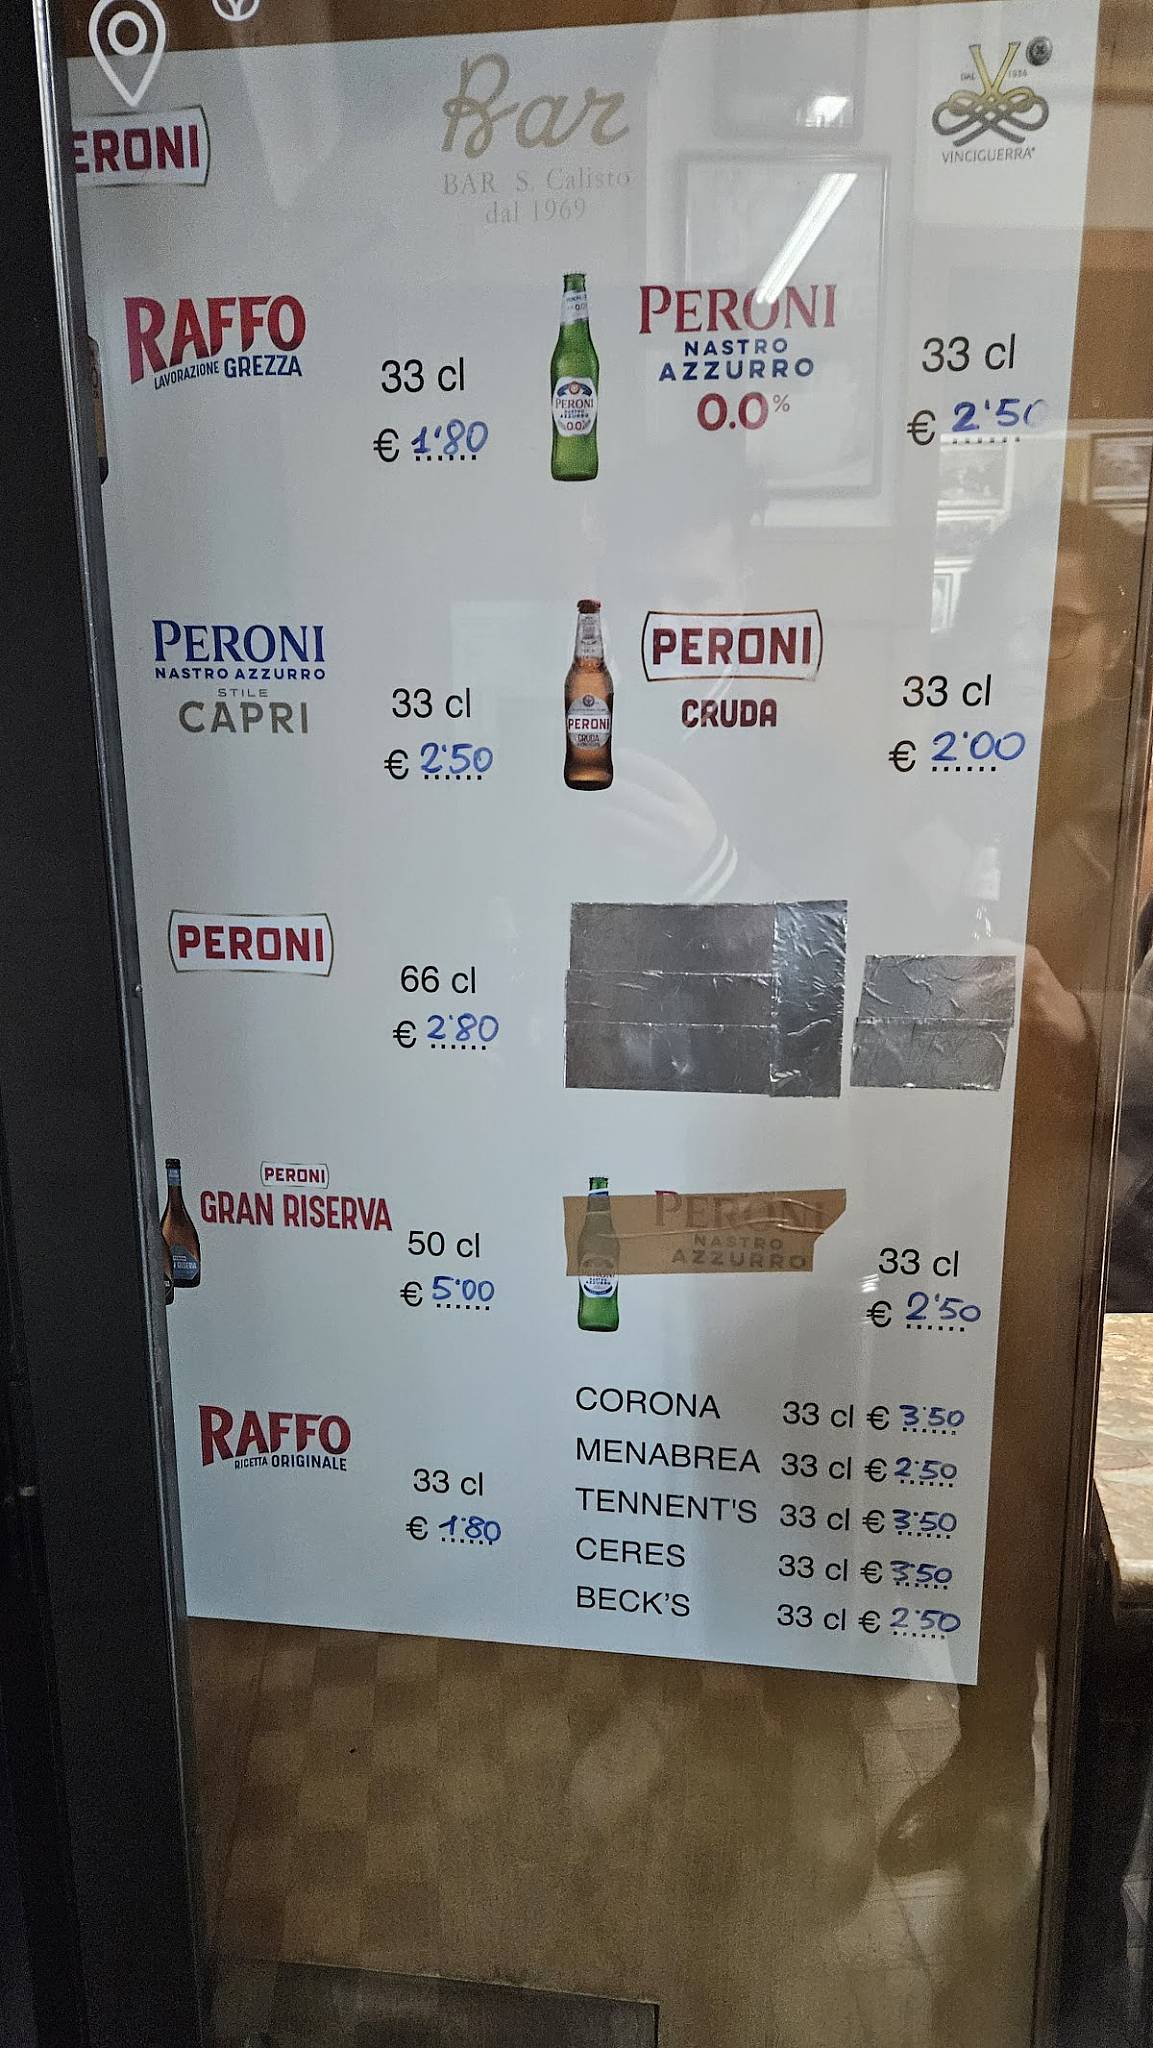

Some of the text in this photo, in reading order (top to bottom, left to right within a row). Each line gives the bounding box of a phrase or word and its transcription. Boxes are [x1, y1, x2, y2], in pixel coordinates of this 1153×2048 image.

[440, 52, 630, 160] Bar
[443, 164, 630, 196] BAR S. Calisto
[485, 197, 586, 225] dal 1969
[640, 284, 837, 334] PERONI
[124, 295, 306, 384] RAFFO
[685, 338, 787, 356] NASTRO
[923, 333, 1015, 372] 33 cl
[154, 355, 302, 390] LAVORAZIONE GREZZA
[382, 357, 464, 393] 33 cl
[659, 357, 814, 381] AZZURRO
[697, 392, 790, 431] 0.0%
[907, 410, 935, 445] €
[373, 429, 399, 462] €
[152, 620, 324, 663] PERONI
[653, 627, 811, 665] PERONI
[155, 668, 325, 680] NASTRO AZZURRO
[218, 688, 268, 697] STILE
[392, 688, 470, 718] 33 cl
[903, 674, 991, 707] 33 cl
[179, 700, 308, 734] CAPRI
[568, 718, 609, 730] PERONI
[682, 699, 777, 728] CRUDA
[384, 749, 408, 780] €
[889, 741, 916, 772] €
[177, 925, 323, 962] PERONI
[401, 966, 475, 993] 66 cl
[393, 1021, 416, 1048] €
[264, 1166, 326, 1184] PERONI
[201, 1191, 392, 1231] GRAN RISERVA
[408, 1231, 479, 1257] 50 cl
[694, 1233, 783, 1250] NASTRO
[671, 1249, 806, 1268] AZZURRO
[879, 1248, 958, 1277] 33 cl
[400, 1282, 422, 1307] €
[867, 1301, 891, 1327] €
[576, 1387, 720, 1419] CORONA
[783, 1401, 819, 1425] 33
[831, 1405, 853, 1428] cl
[867, 1406, 889, 1430] €
[199, 1405, 351, 1467] RAFFO
[235, 1454, 347, 1471] RICETTA ORIGINALE
[577, 1438, 760, 1473] MENABREA
[781, 1453, 817, 1477] 33
[829, 1457, 851, 1480] cl
[864, 1458, 887, 1482] €
[414, 1469, 482, 1496] 33 cl
[575, 1488, 756, 1523] TENNENT'S
[780, 1504, 815, 1528] 33
[827, 1508, 849, 1531] cl
[862, 1510, 884, 1533] €
[406, 1516, 428, 1540] €
[576, 1537, 685, 1567] CERES
[779, 1555, 814, 1578] 33
[826, 1559, 848, 1581] cl
[860, 1561, 882, 1584] €
[577, 1586, 689, 1616] BECK'S
[777, 1604, 812, 1627] 33
[824, 1609, 845, 1630] cl
[858, 1611, 880, 1633] €
